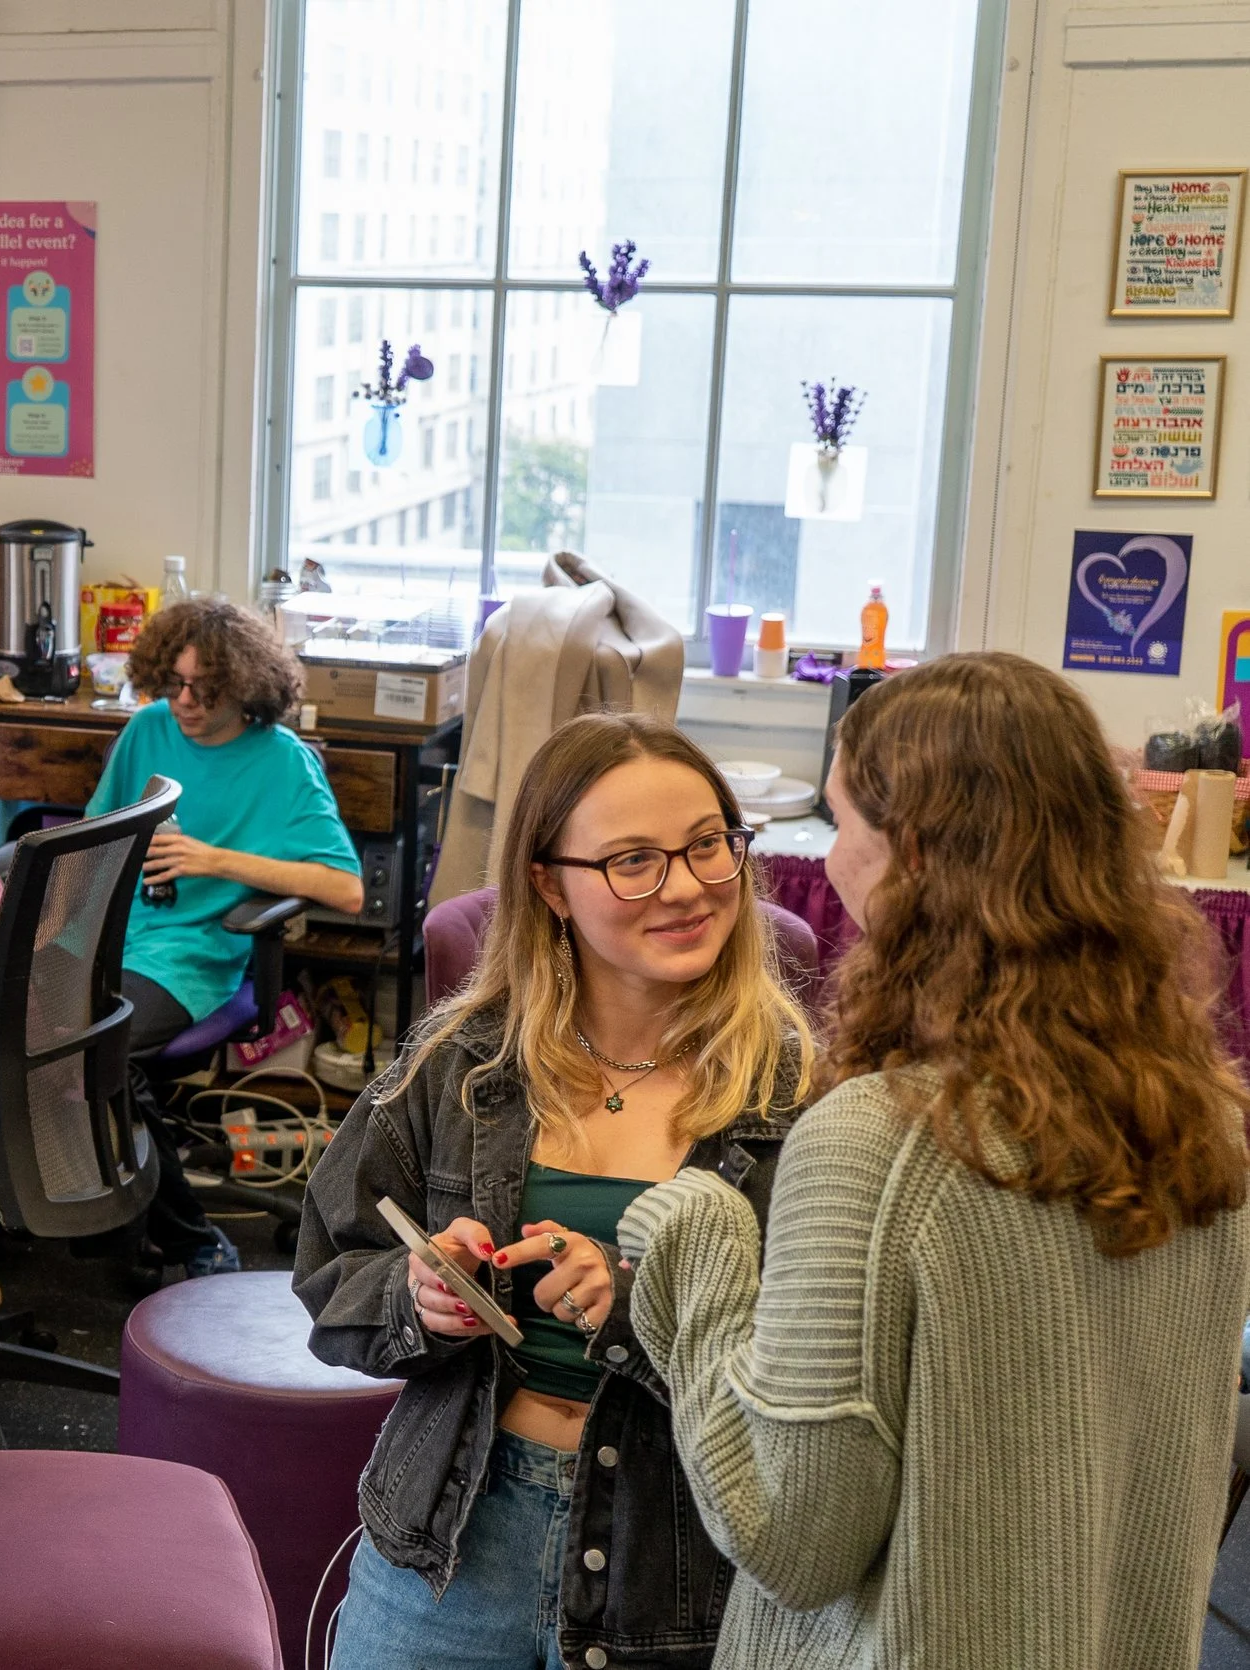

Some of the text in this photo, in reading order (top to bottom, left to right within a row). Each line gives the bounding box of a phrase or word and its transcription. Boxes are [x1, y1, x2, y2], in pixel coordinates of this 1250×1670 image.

[1171, 182, 1210, 193] HOME
[1147, 202, 1189, 213] HEALTH
[29, 213, 50, 229] for
[54, 217, 63, 229] a
[26, 234, 76, 249] event?
[1130, 235, 1165, 246] HOPE
[1184, 234, 1225, 246] HOME
[1, 256, 8, 266] it
[10, 256, 47, 268] happen!
[1158, 383, 1205, 394] ברכת
[1156, 417, 1203, 428] אהבה
[1111, 457, 1164, 471] הצלחה
